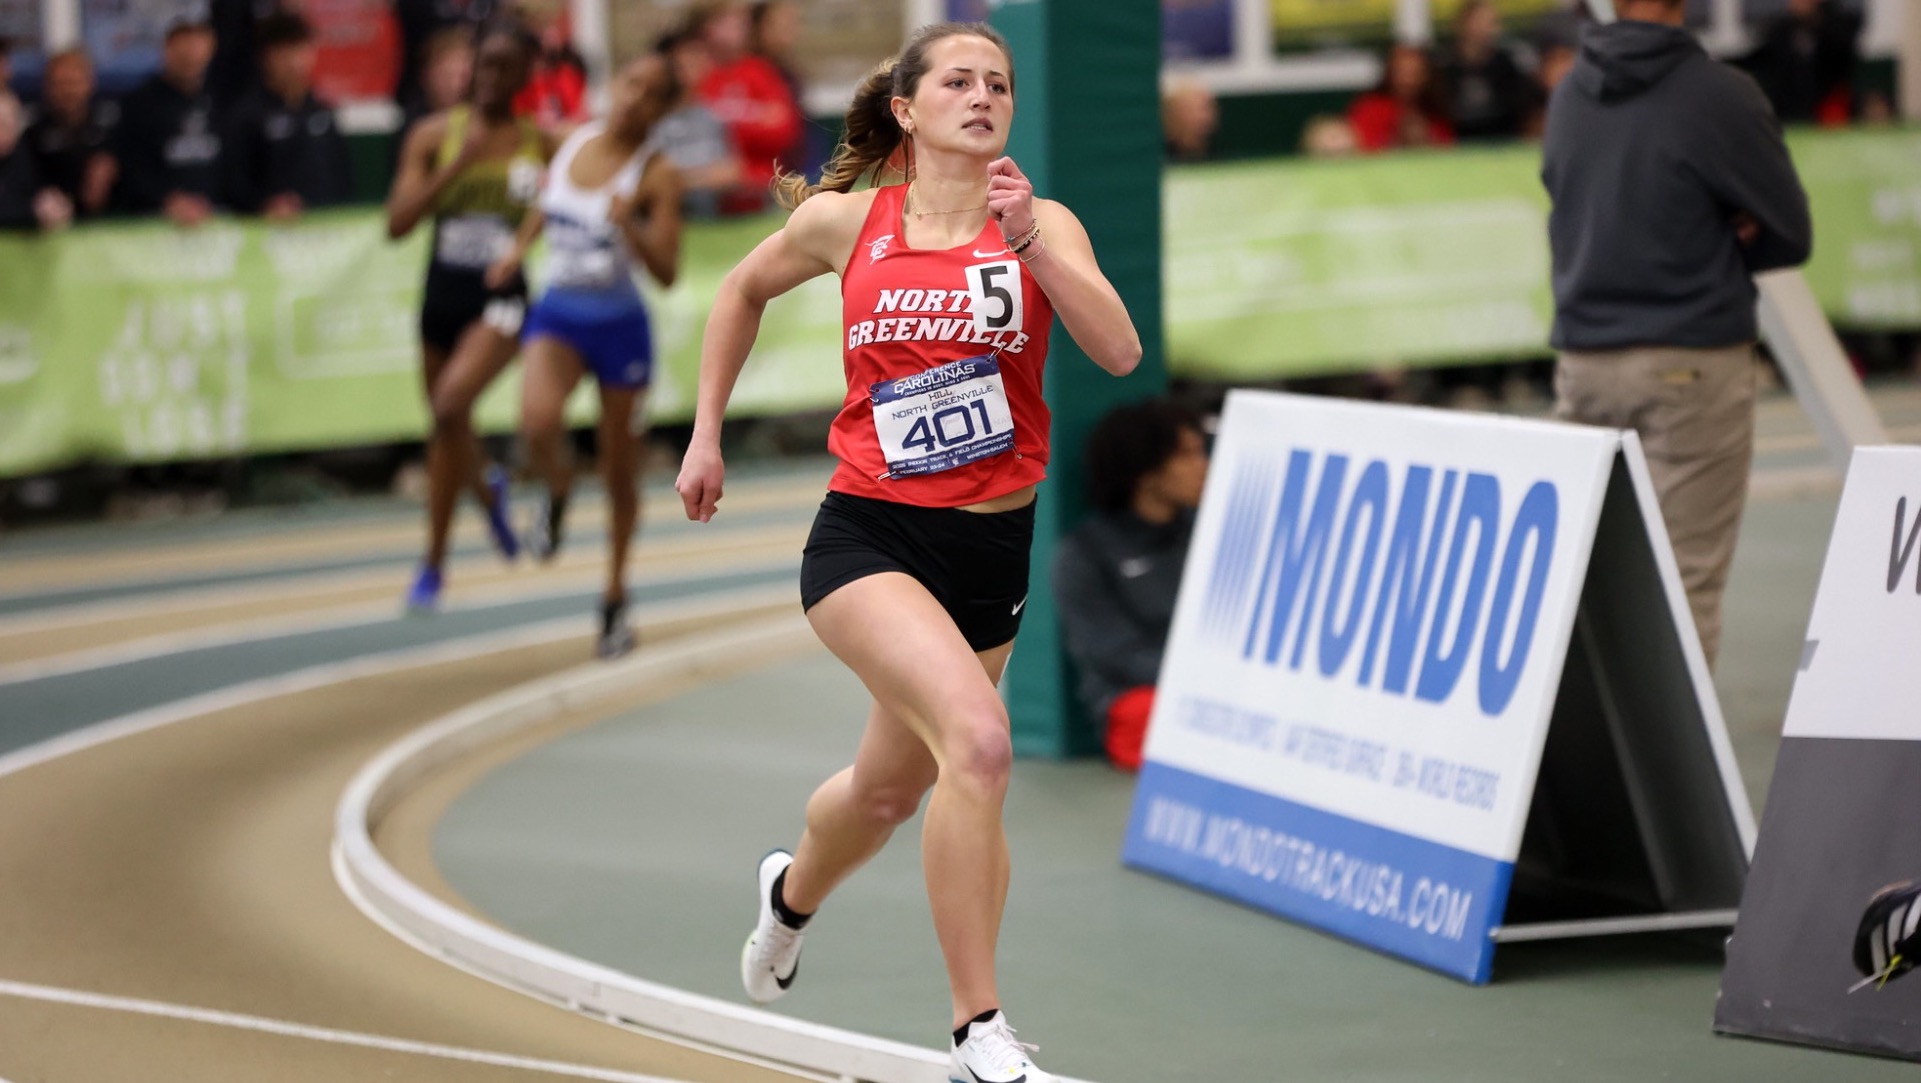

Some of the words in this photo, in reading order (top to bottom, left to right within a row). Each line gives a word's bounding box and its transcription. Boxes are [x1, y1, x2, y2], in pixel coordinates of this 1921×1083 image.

[979, 265, 1014, 328] 5
[892, 404, 927, 420] NORTH
[932, 385, 994, 410] GREENVILLE
[894, 363, 976, 395] CAROLINAS
[928, 389, 953, 401] HILL
[902, 398, 992, 453] 401
[1241, 447, 1560, 716] MONDO
[1143, 797, 1472, 941] WWW.MONDOTRACKUSA.COM
